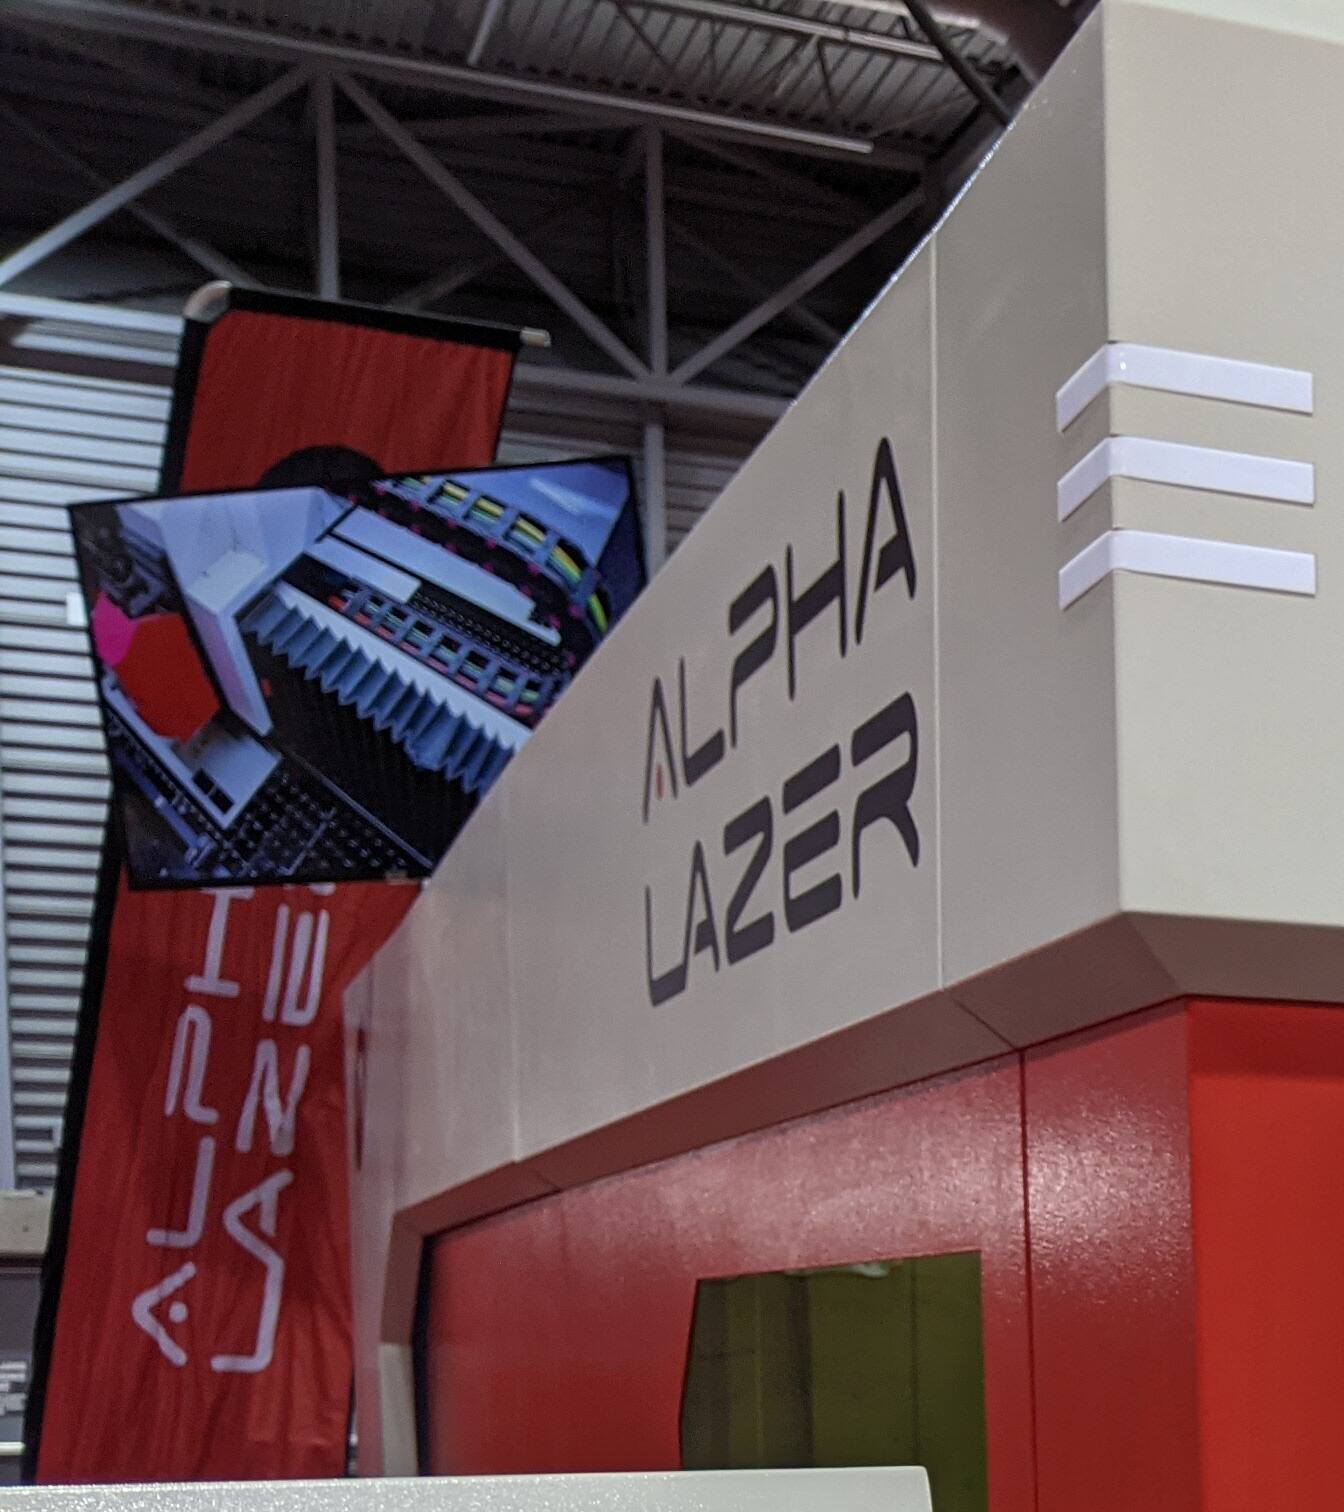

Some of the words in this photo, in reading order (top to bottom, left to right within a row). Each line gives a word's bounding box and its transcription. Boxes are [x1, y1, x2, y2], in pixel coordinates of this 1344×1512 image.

[641, 436, 916, 824] ALPHA
[645, 692, 919, 1007] LAZER
[131, 886, 255, 1367] ALPH
[210, 882, 337, 1373] LAZE
